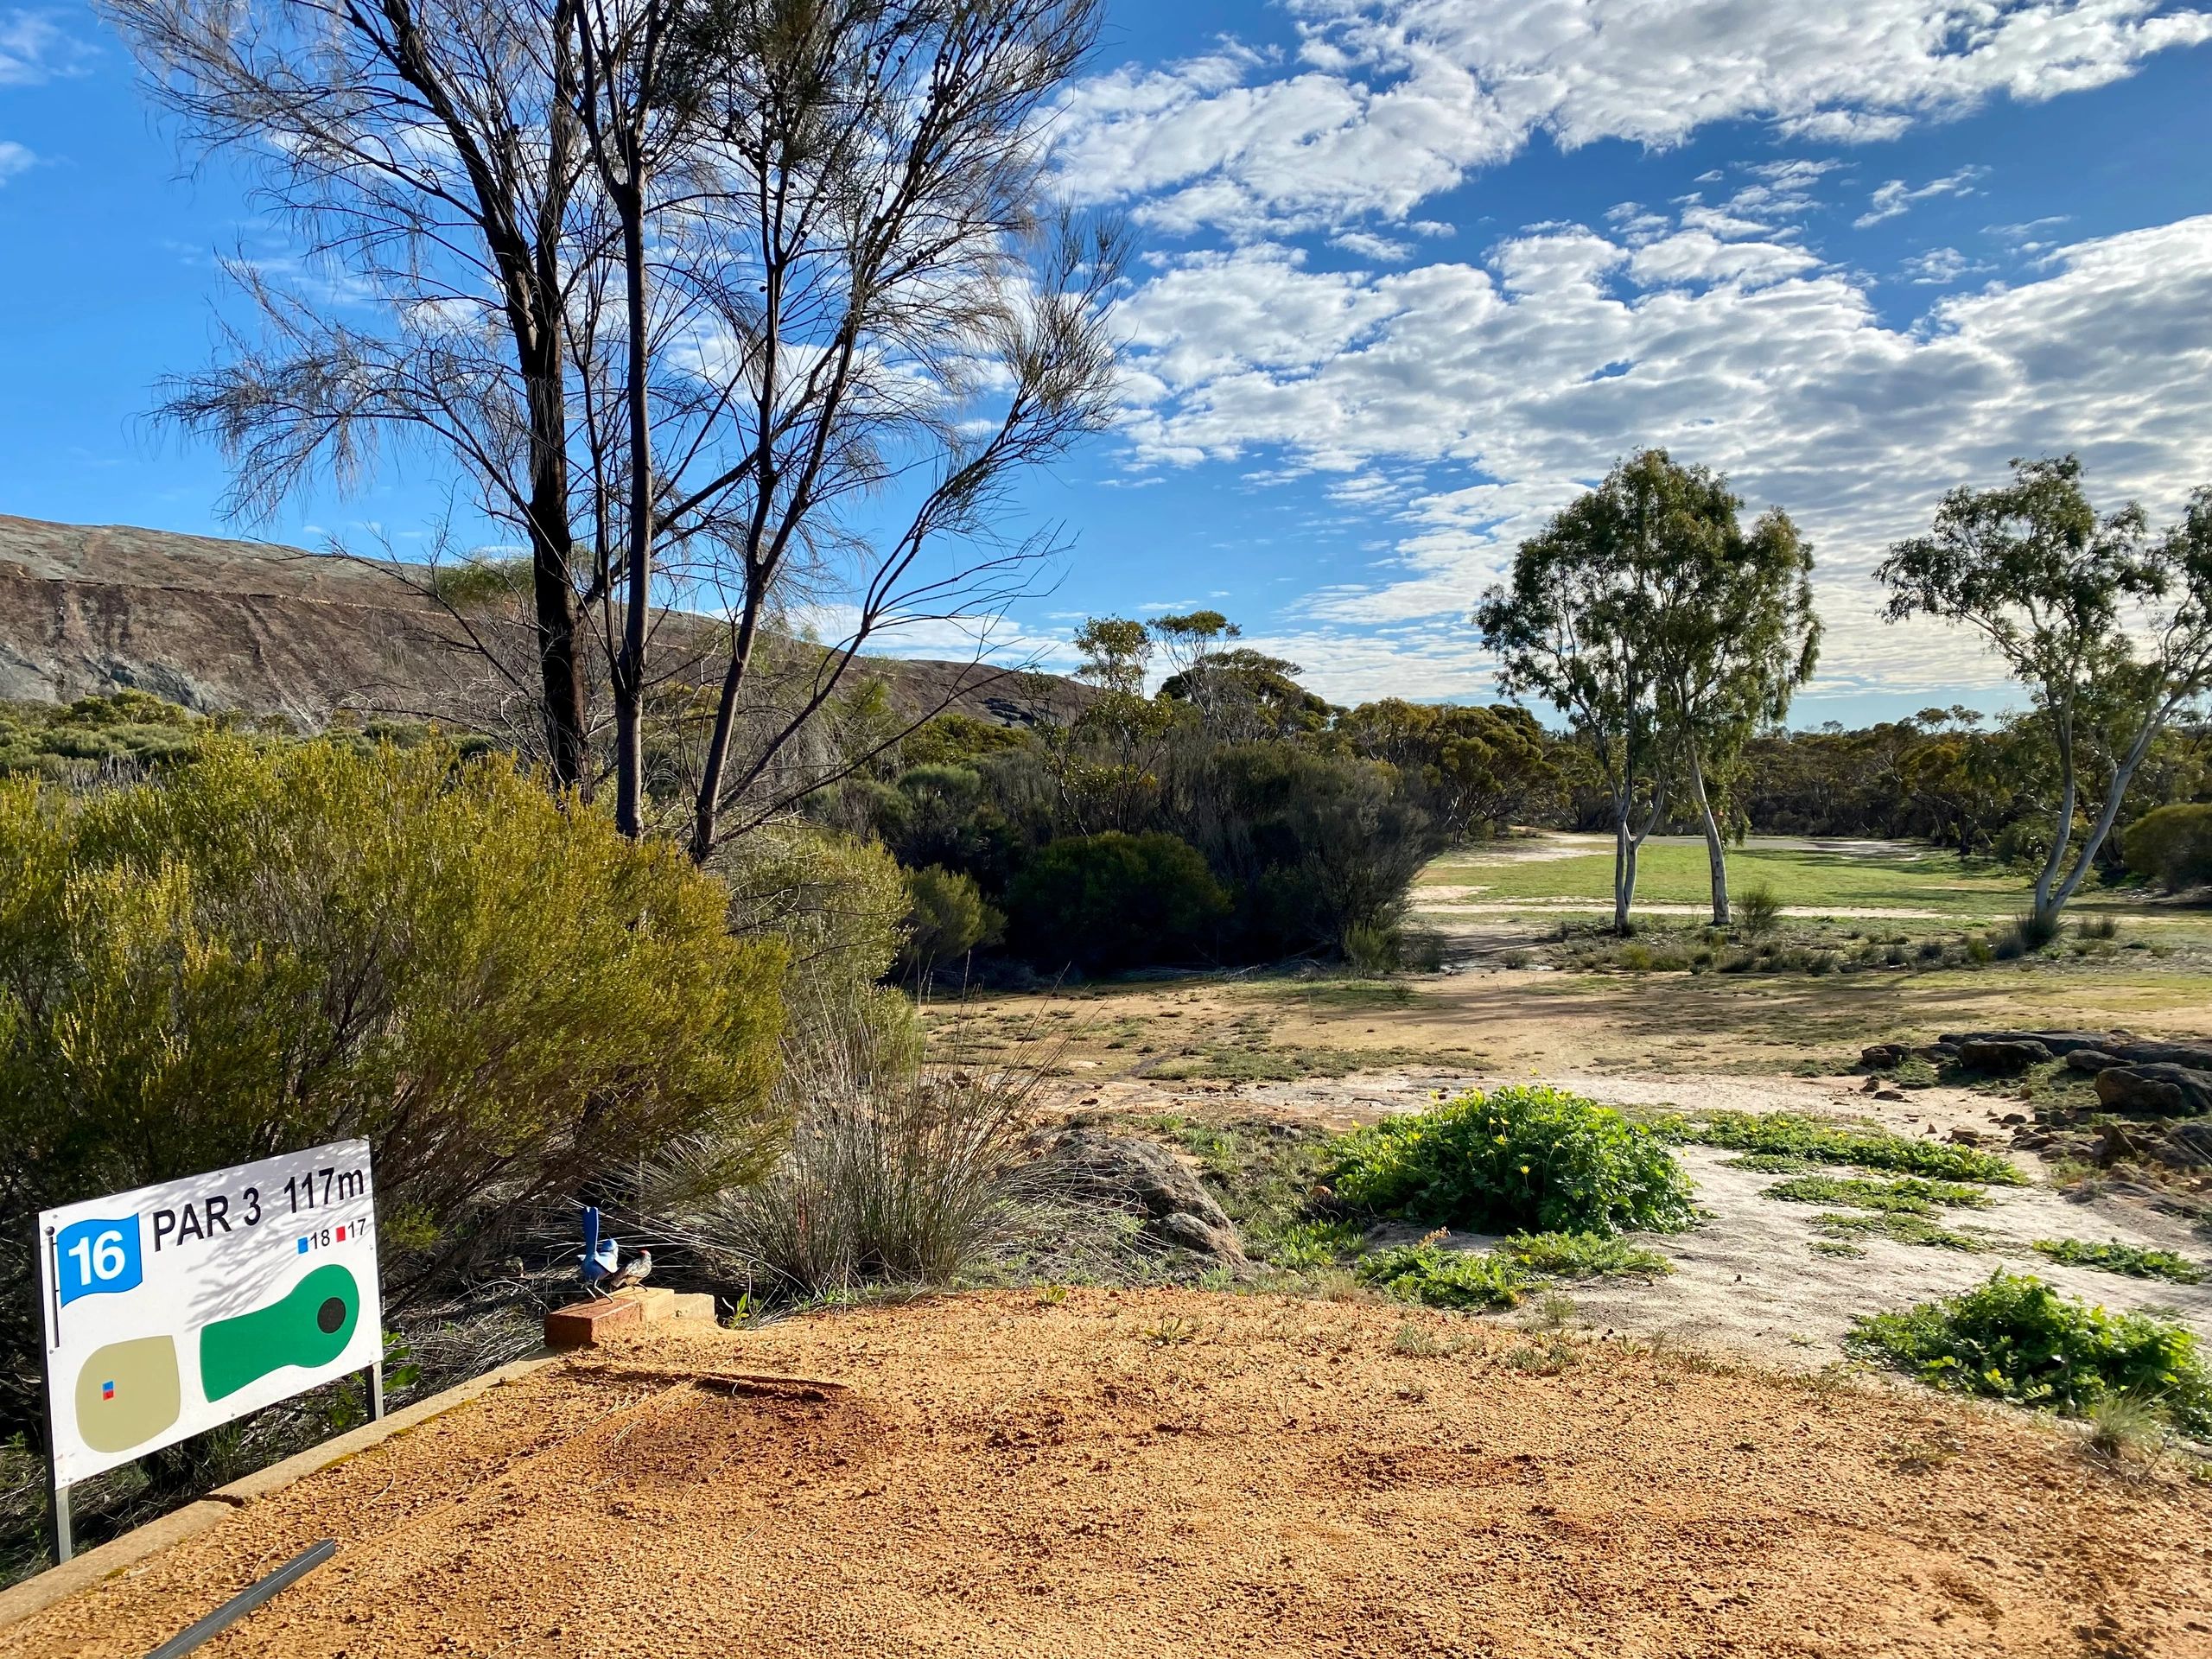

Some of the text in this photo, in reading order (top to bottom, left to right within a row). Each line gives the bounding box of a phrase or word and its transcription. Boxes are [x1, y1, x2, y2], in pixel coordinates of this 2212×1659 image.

[153, 1167, 365, 1252] PAR 3 117m
[309, 1217, 366, 1249] 18 17
[68, 1230, 125, 1286] 16
